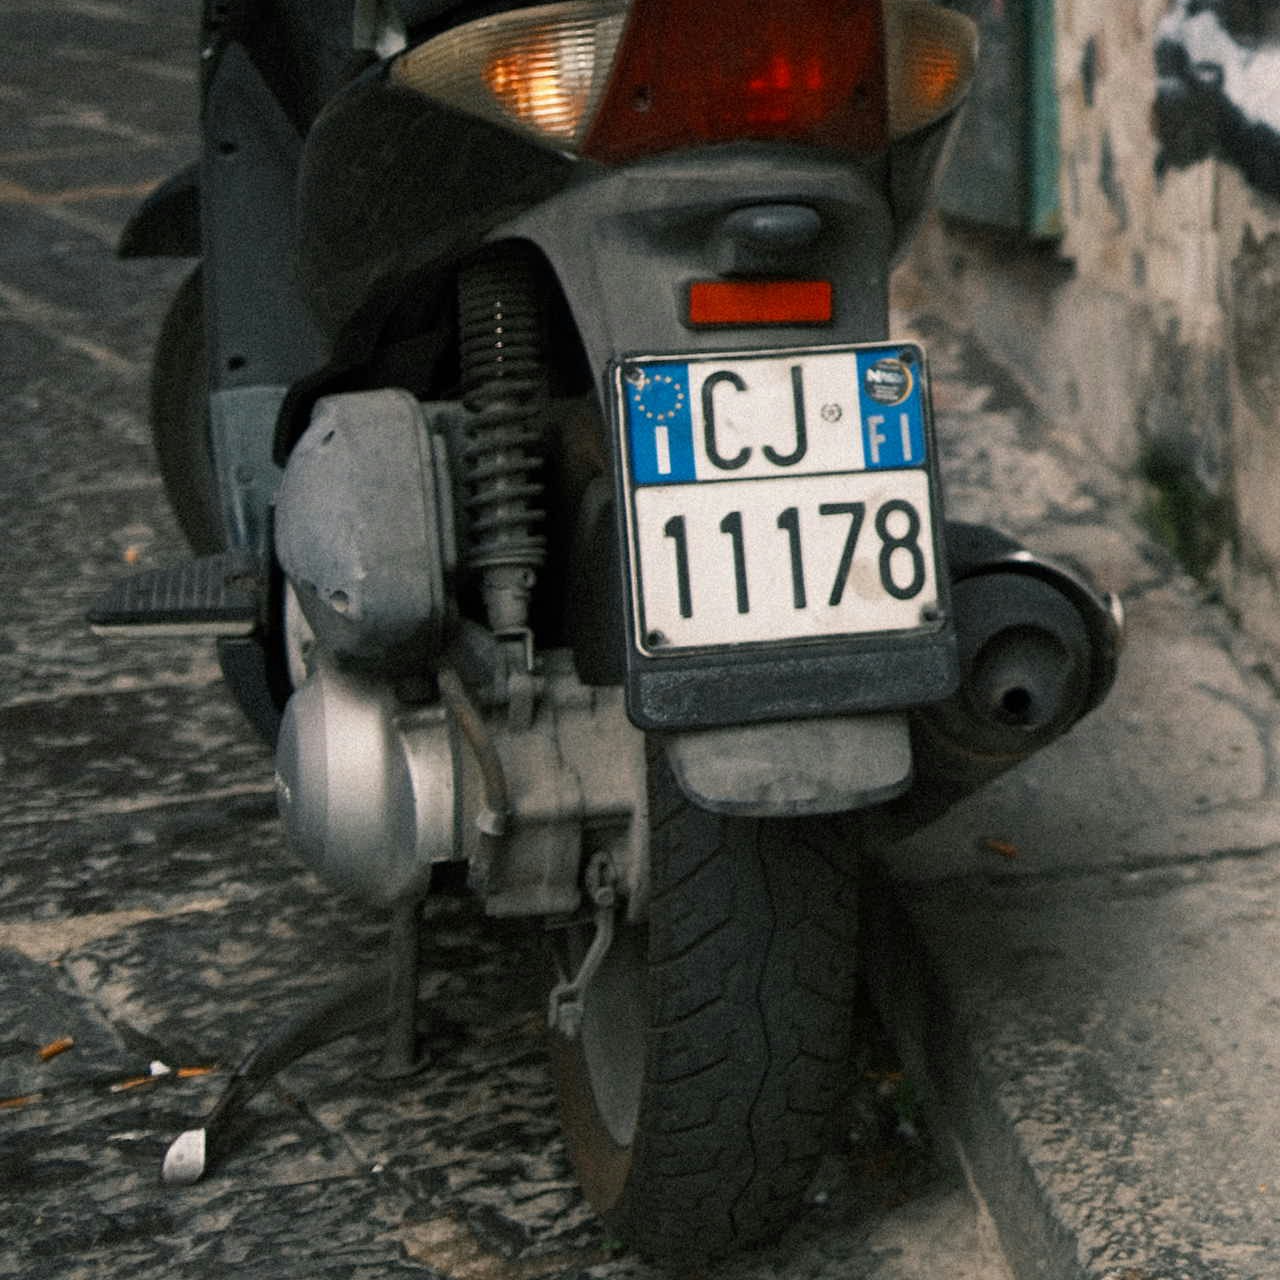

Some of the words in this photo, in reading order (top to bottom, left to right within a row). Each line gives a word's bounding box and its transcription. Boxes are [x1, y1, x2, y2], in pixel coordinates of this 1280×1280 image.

[655, 425, 672, 475] I
[702, 365, 808, 470] CJ
[663, 499, 926, 619] 11178
